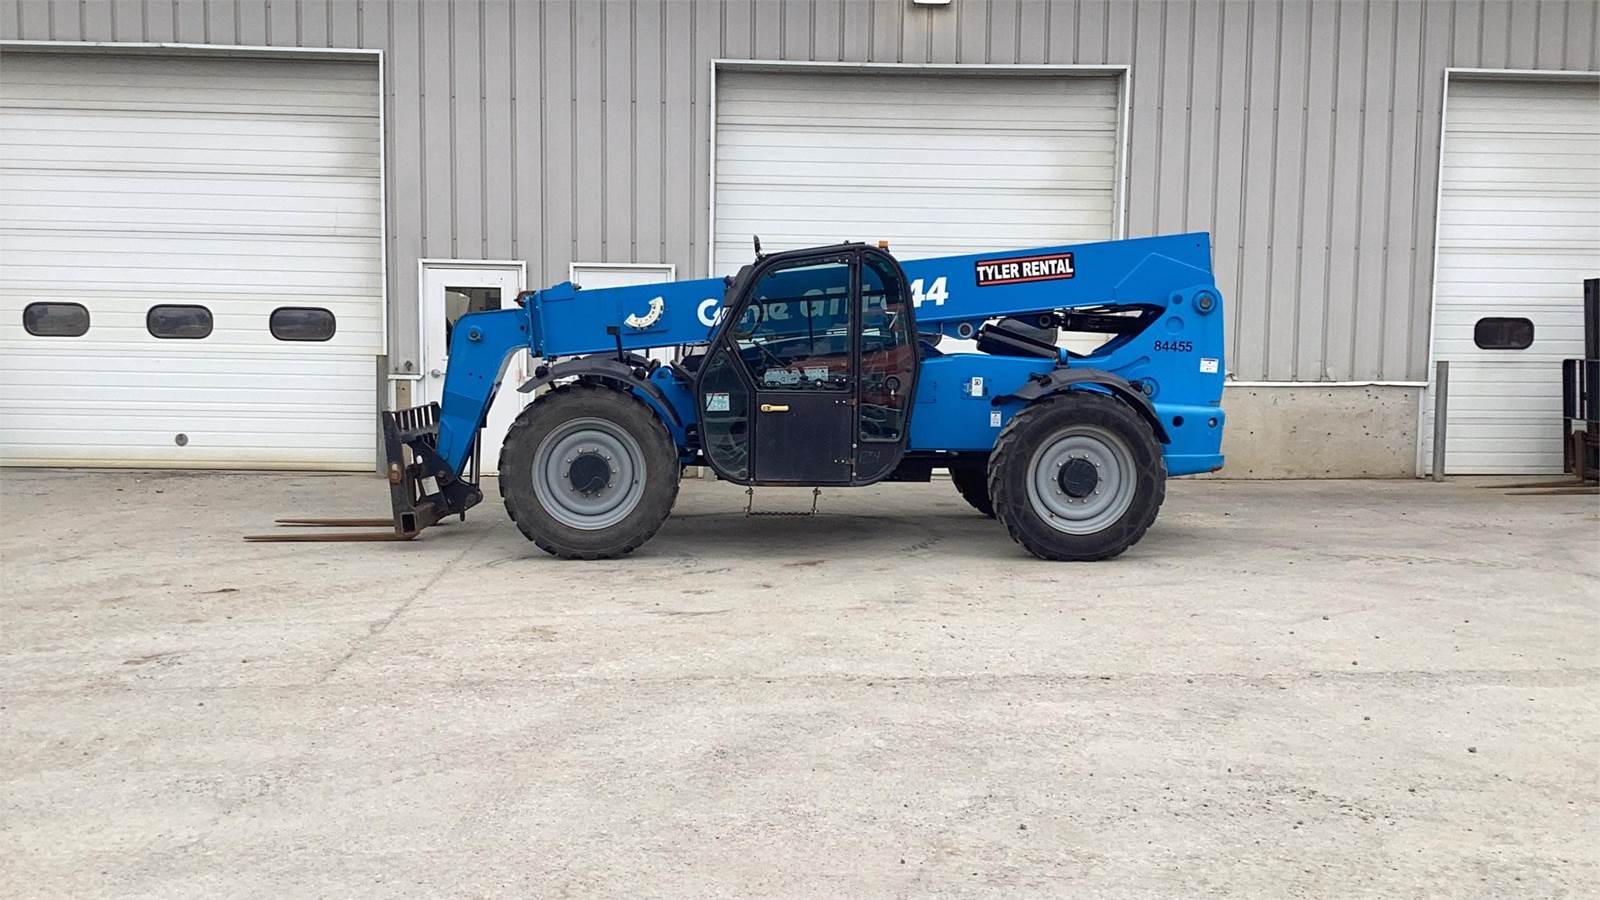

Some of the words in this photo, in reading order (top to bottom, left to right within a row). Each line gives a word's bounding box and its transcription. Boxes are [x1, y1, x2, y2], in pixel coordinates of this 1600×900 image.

[976, 263, 1020, 281] TYLER
[1022, 258, 1074, 277] RENTAL
[1154, 340, 1193, 352] 84455
